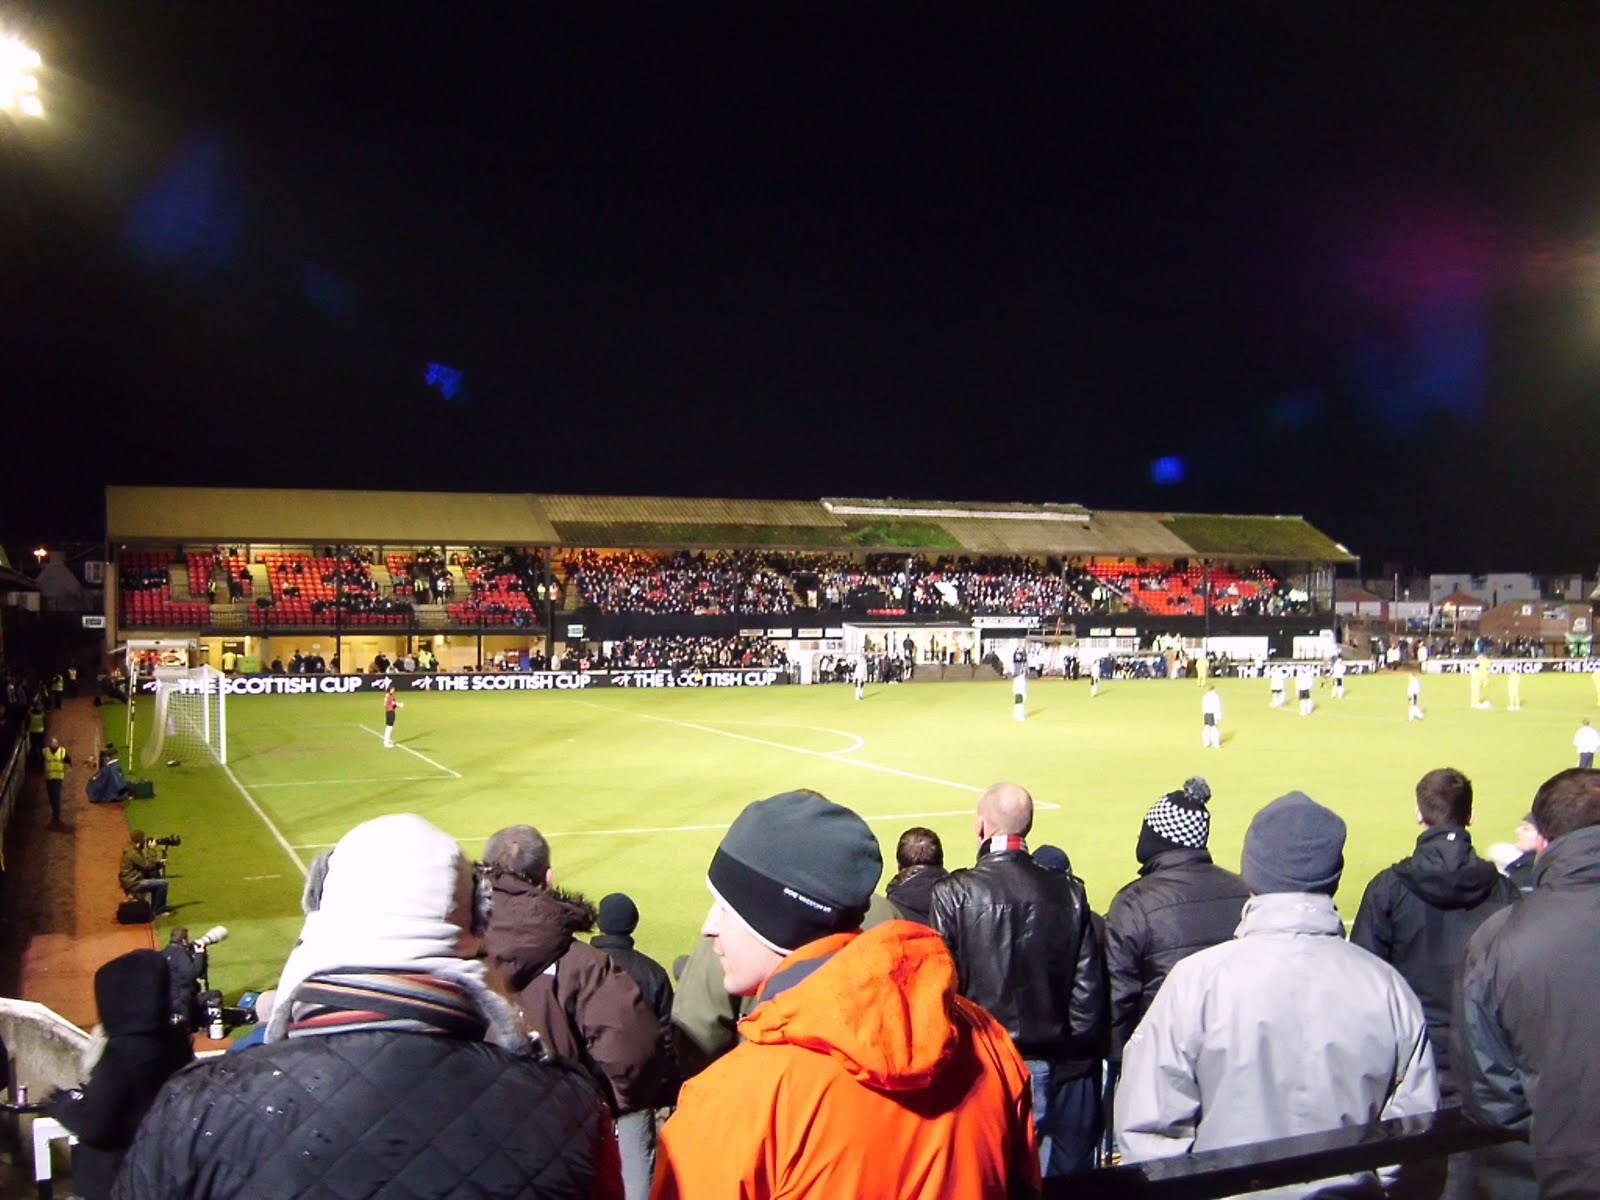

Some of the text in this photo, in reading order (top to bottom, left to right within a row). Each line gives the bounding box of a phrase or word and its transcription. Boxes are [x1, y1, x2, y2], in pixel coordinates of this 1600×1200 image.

[177, 676, 363, 694] THE SCOTTISH CUP
[436, 674, 591, 691] THE SCOTTISH CUP
[633, 673, 665, 687] THE
[744, 671, 777, 686] CUP
